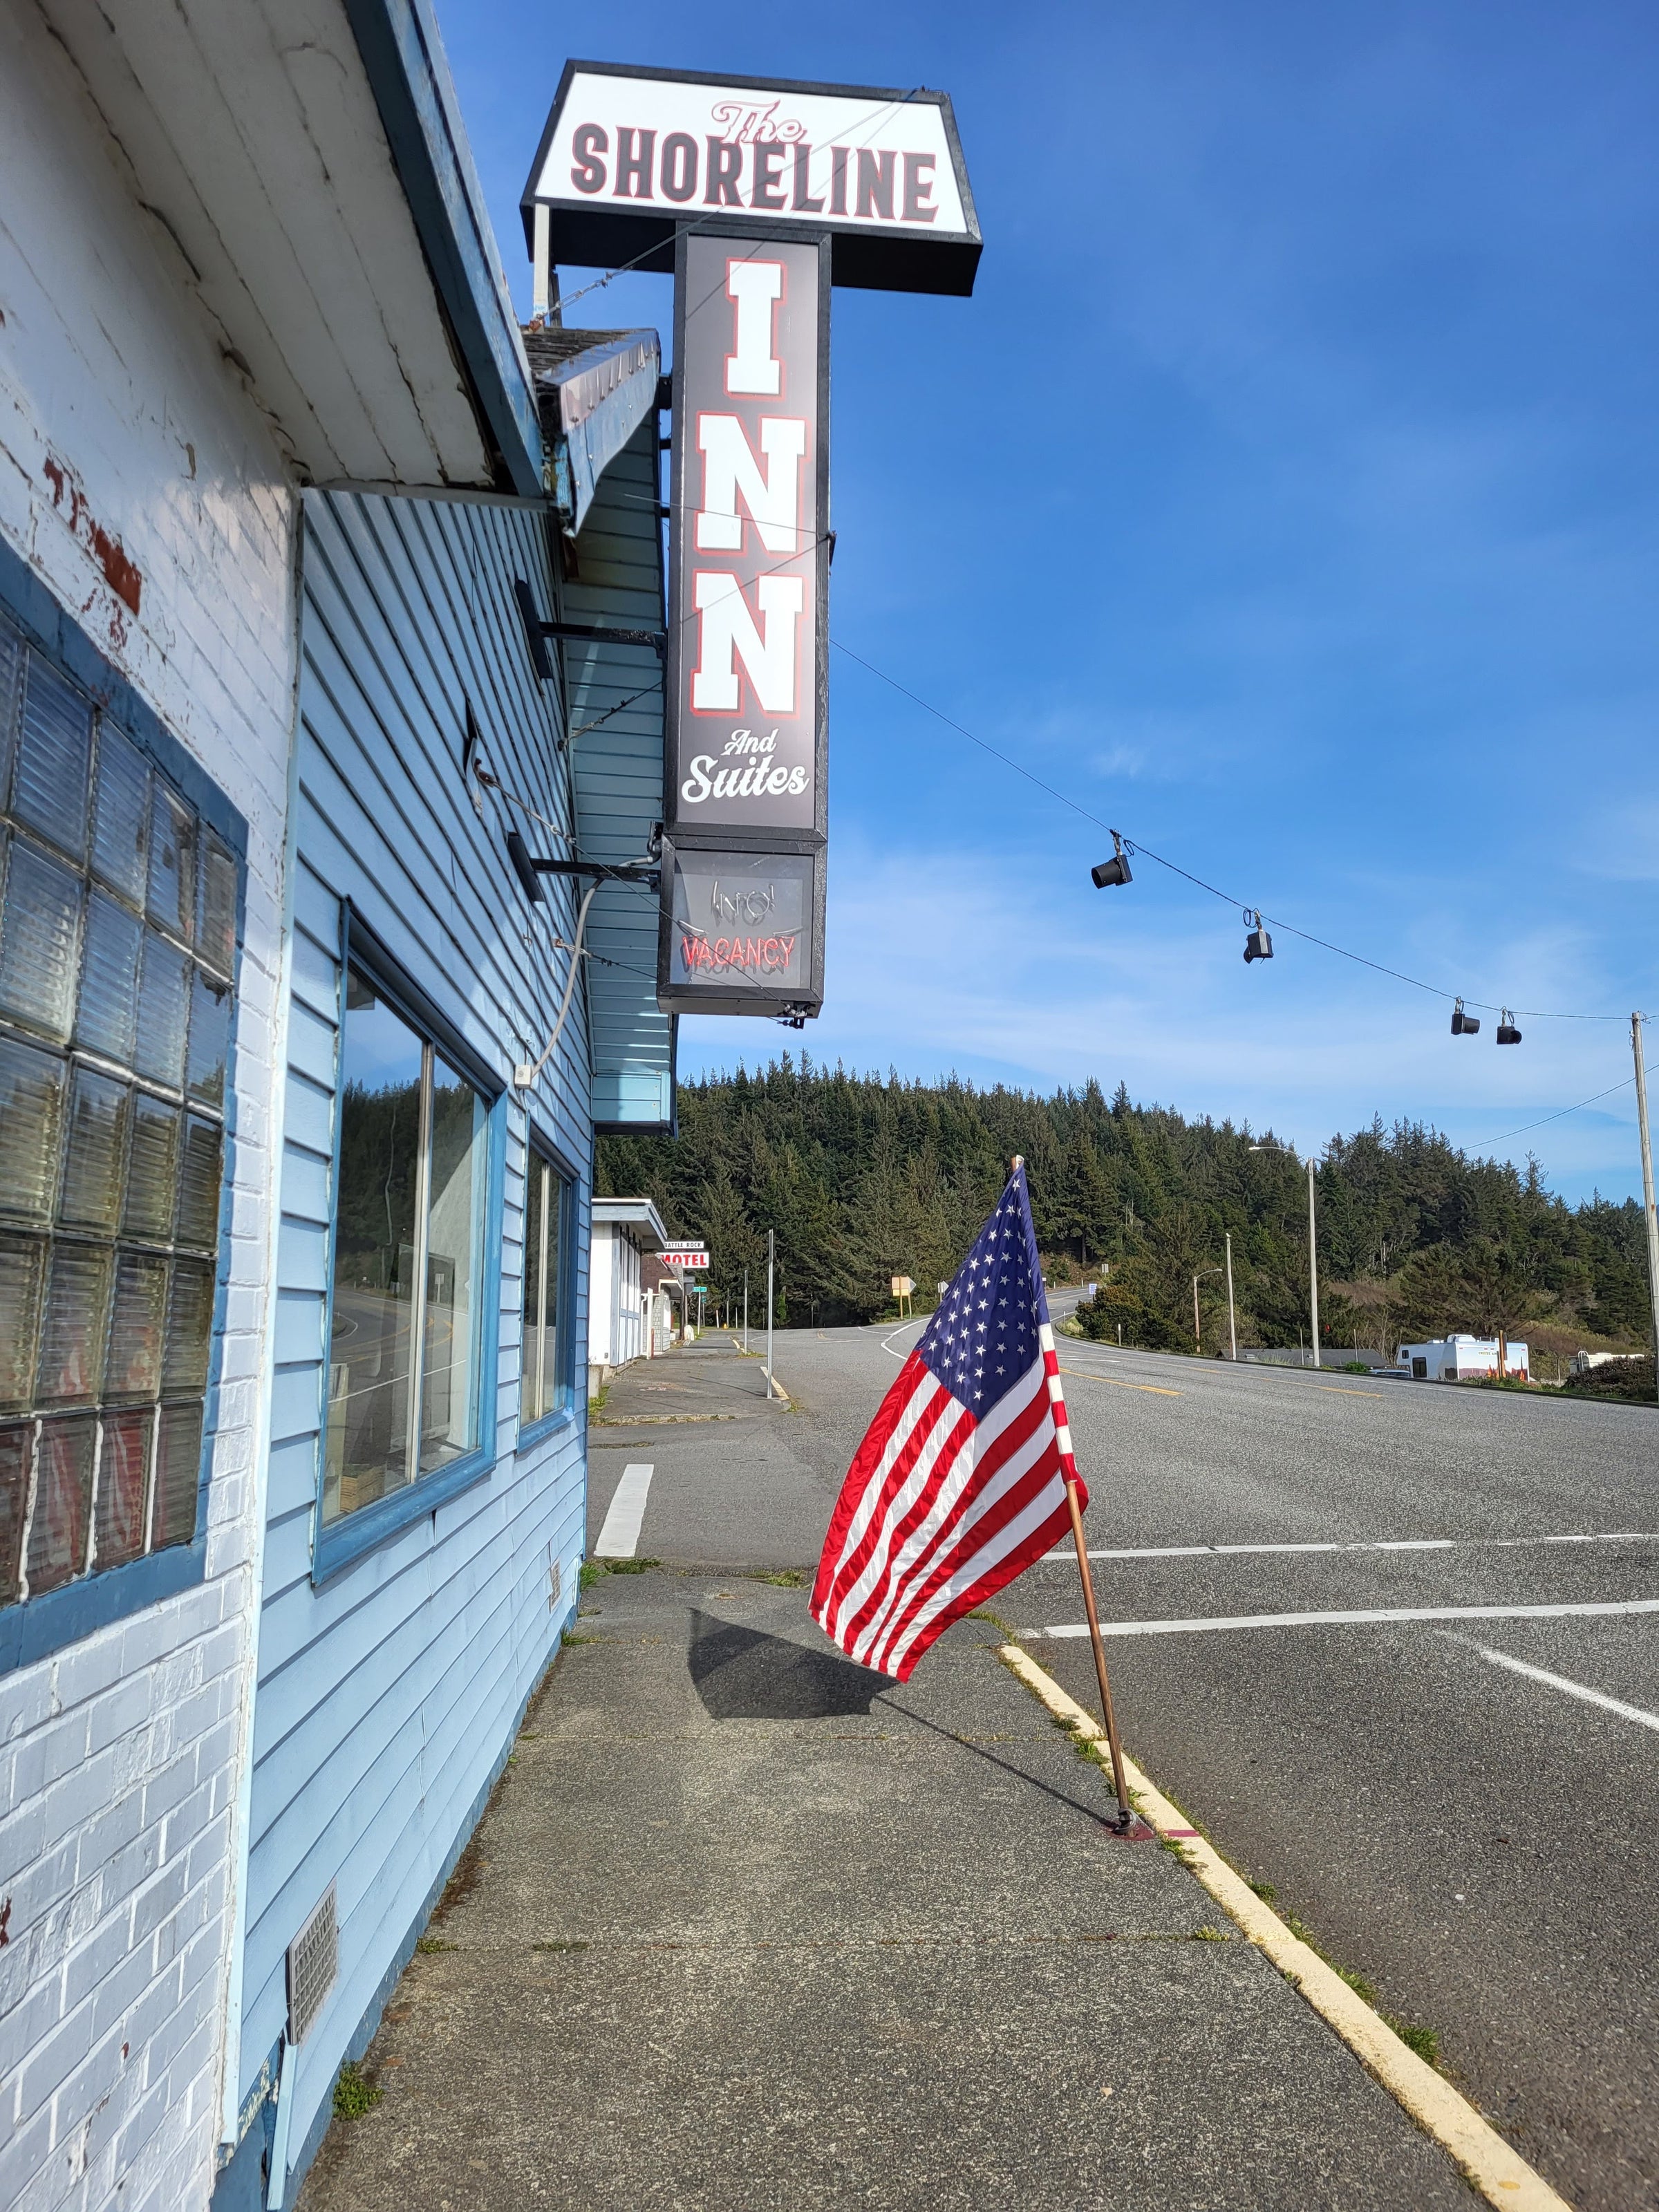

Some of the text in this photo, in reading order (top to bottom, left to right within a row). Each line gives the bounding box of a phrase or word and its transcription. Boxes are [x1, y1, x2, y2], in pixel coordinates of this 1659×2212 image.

[711, 99, 807, 144] The
[570, 122, 939, 223] SHORELINE
[691, 257, 812, 718] INN
[720, 728, 779, 758] And
[681, 754, 810, 803] Suites
[682, 936, 795, 968] VACANCY
